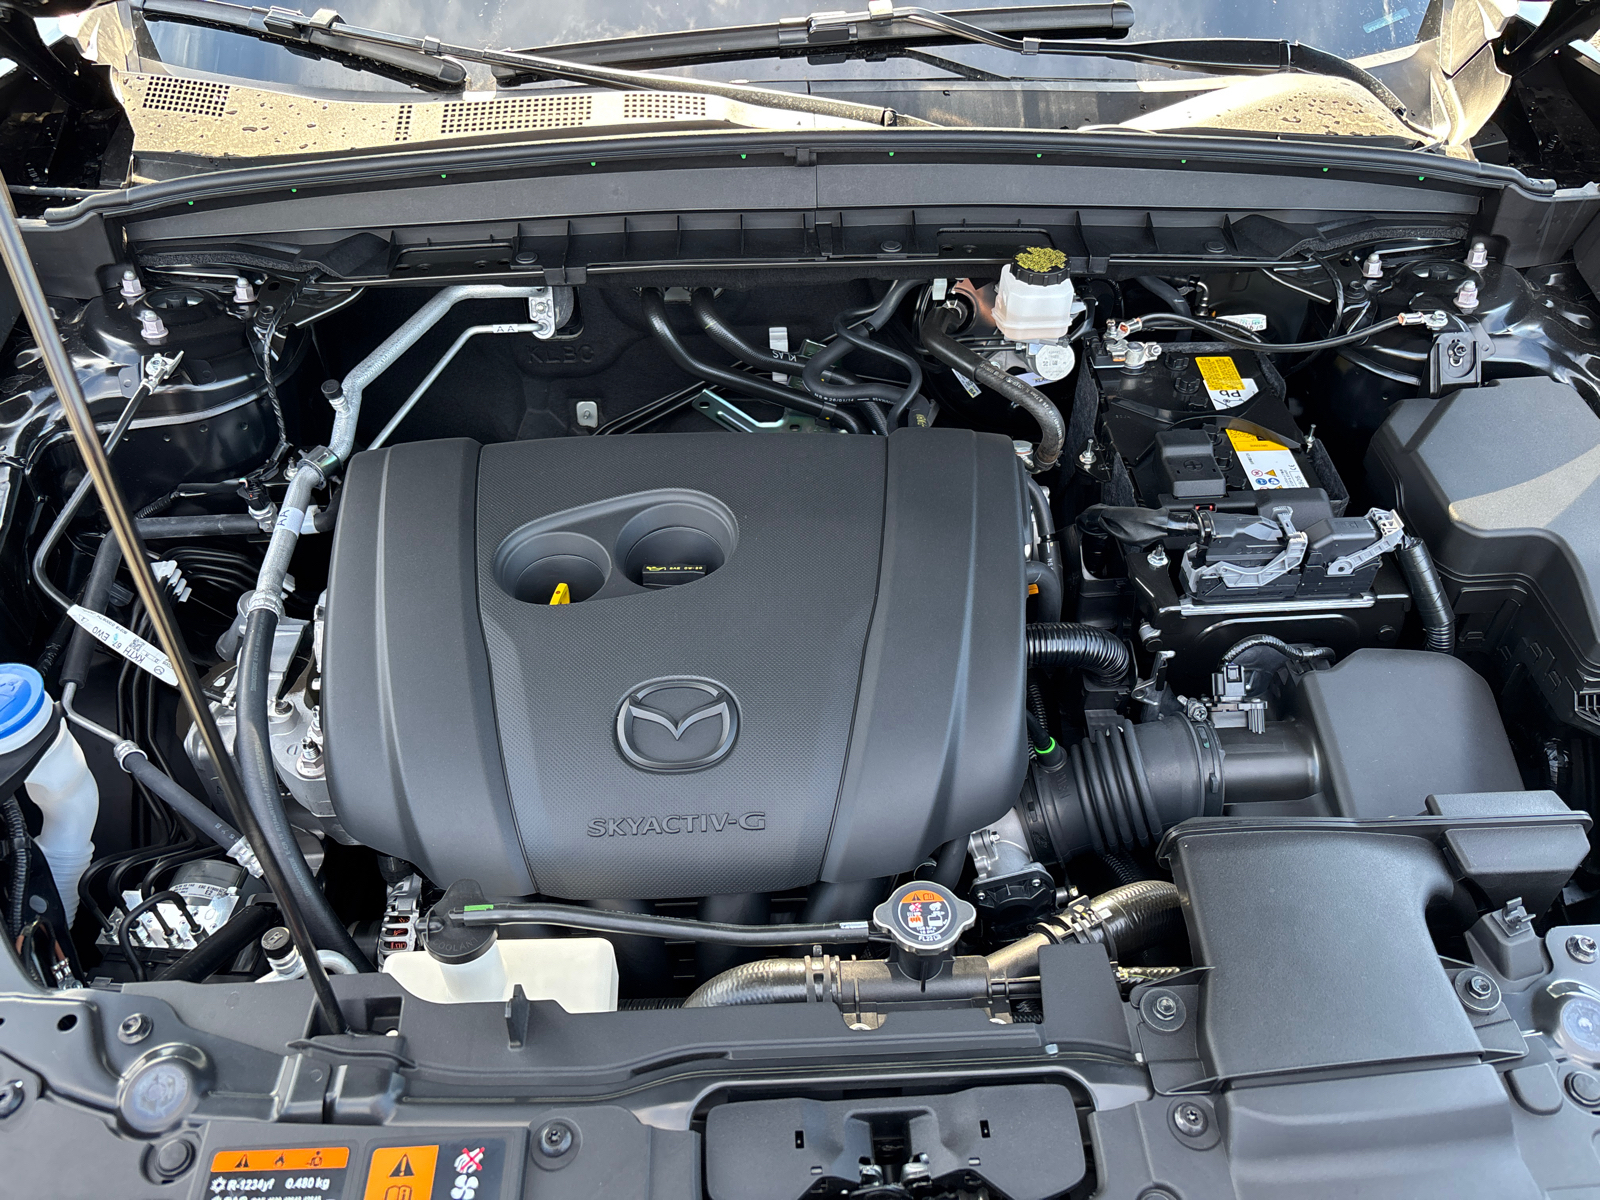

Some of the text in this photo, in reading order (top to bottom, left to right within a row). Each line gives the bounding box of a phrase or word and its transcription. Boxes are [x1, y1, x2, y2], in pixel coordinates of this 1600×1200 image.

[122, 645, 145, 664] KKTH
[587, 812, 766, 837] SKYACTIV-G
[226, 1178, 276, 1193] R-1234yf
[315, 1176, 330, 1191] kg
